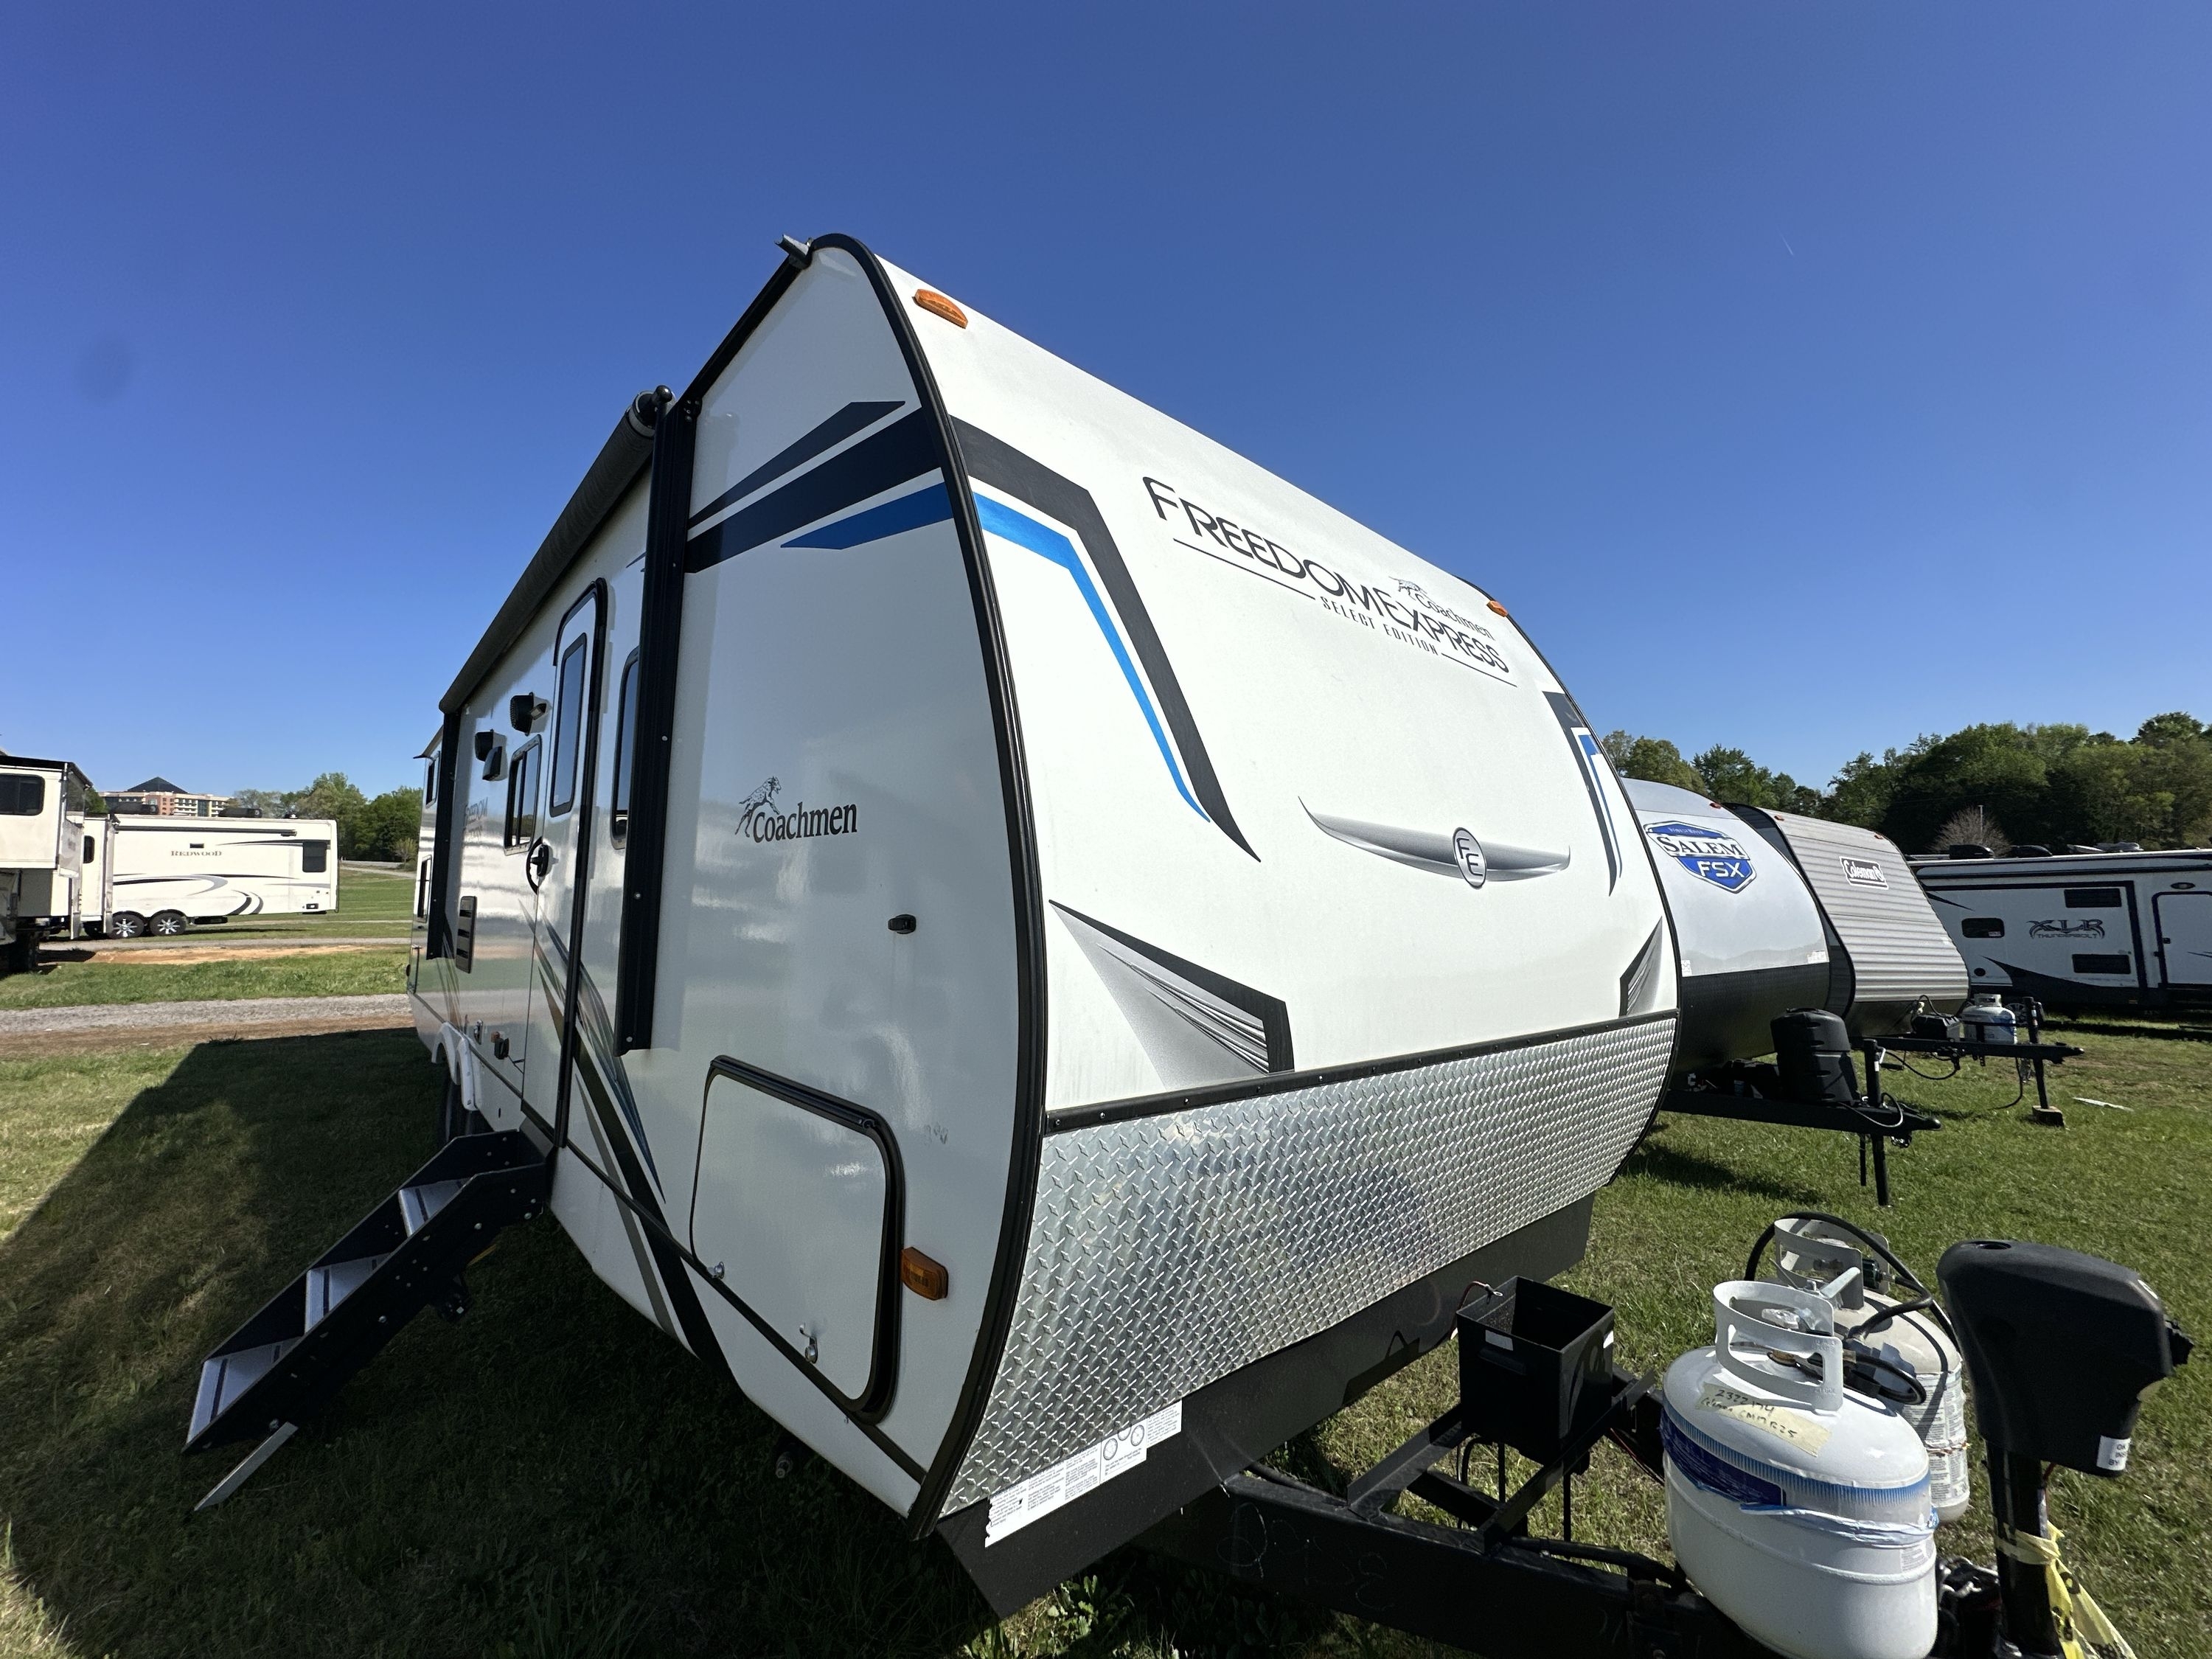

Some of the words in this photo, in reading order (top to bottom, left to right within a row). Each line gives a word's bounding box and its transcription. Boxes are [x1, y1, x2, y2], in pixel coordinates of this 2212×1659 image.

[1320, 596, 1376, 630] SELECT
[1383, 623, 1439, 655] EDITION
[1415, 592, 1497, 641] Coachmen
[753, 801, 858, 844] Coachmen
[1455, 837, 1484, 877] FE
[1656, 836, 1746, 856] SALEM
[1697, 860, 1745, 878] FSX
[1843, 860, 1878, 880] Coleman
[2025, 919, 2105, 939] XLR
